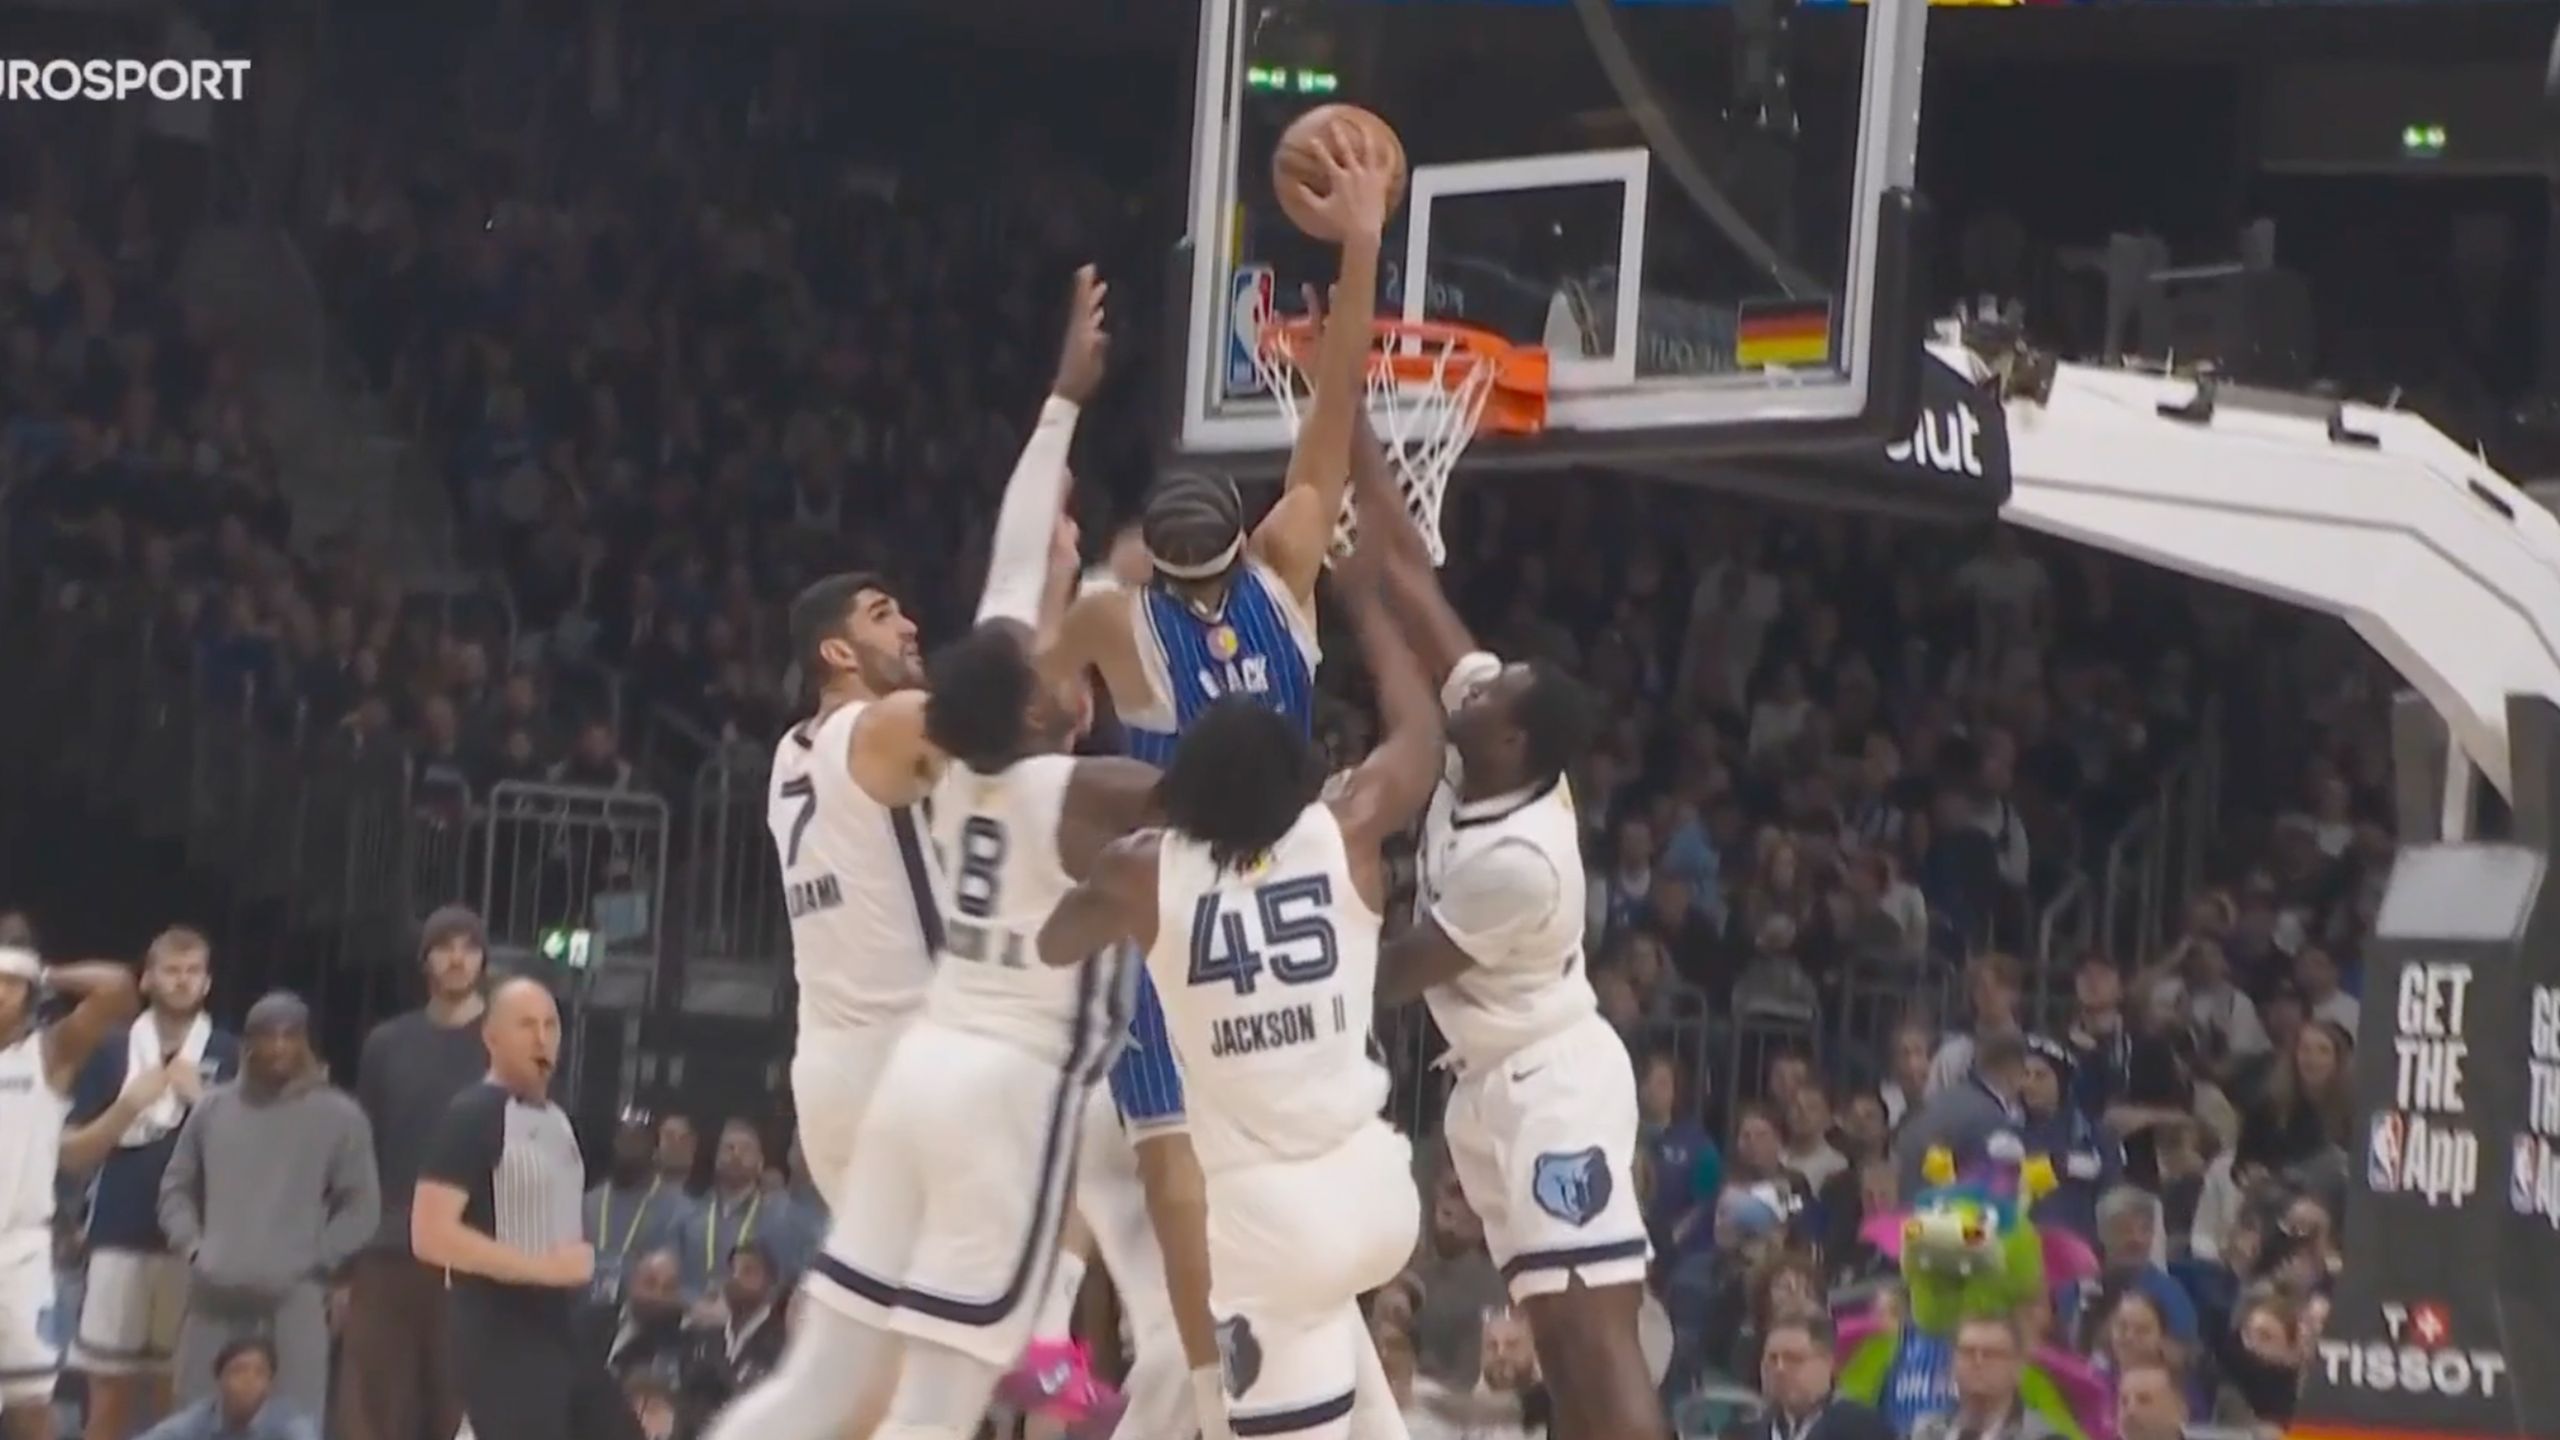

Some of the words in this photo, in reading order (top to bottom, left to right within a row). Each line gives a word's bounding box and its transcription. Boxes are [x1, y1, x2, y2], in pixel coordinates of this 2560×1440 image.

[781, 773, 817, 869] 7
[959, 814, 1009, 919] 8
[1187, 872, 1339, 996] 45
[1211, 1003, 1316, 1057] JACKSON
[2398, 962, 2473, 1037] GET
[2394, 1035, 2468, 1113] THE
[2528, 1057, 2560, 1136] TH
[2402, 1112, 2479, 1208] App
[2317, 1341, 2506, 1398] TISSOT
